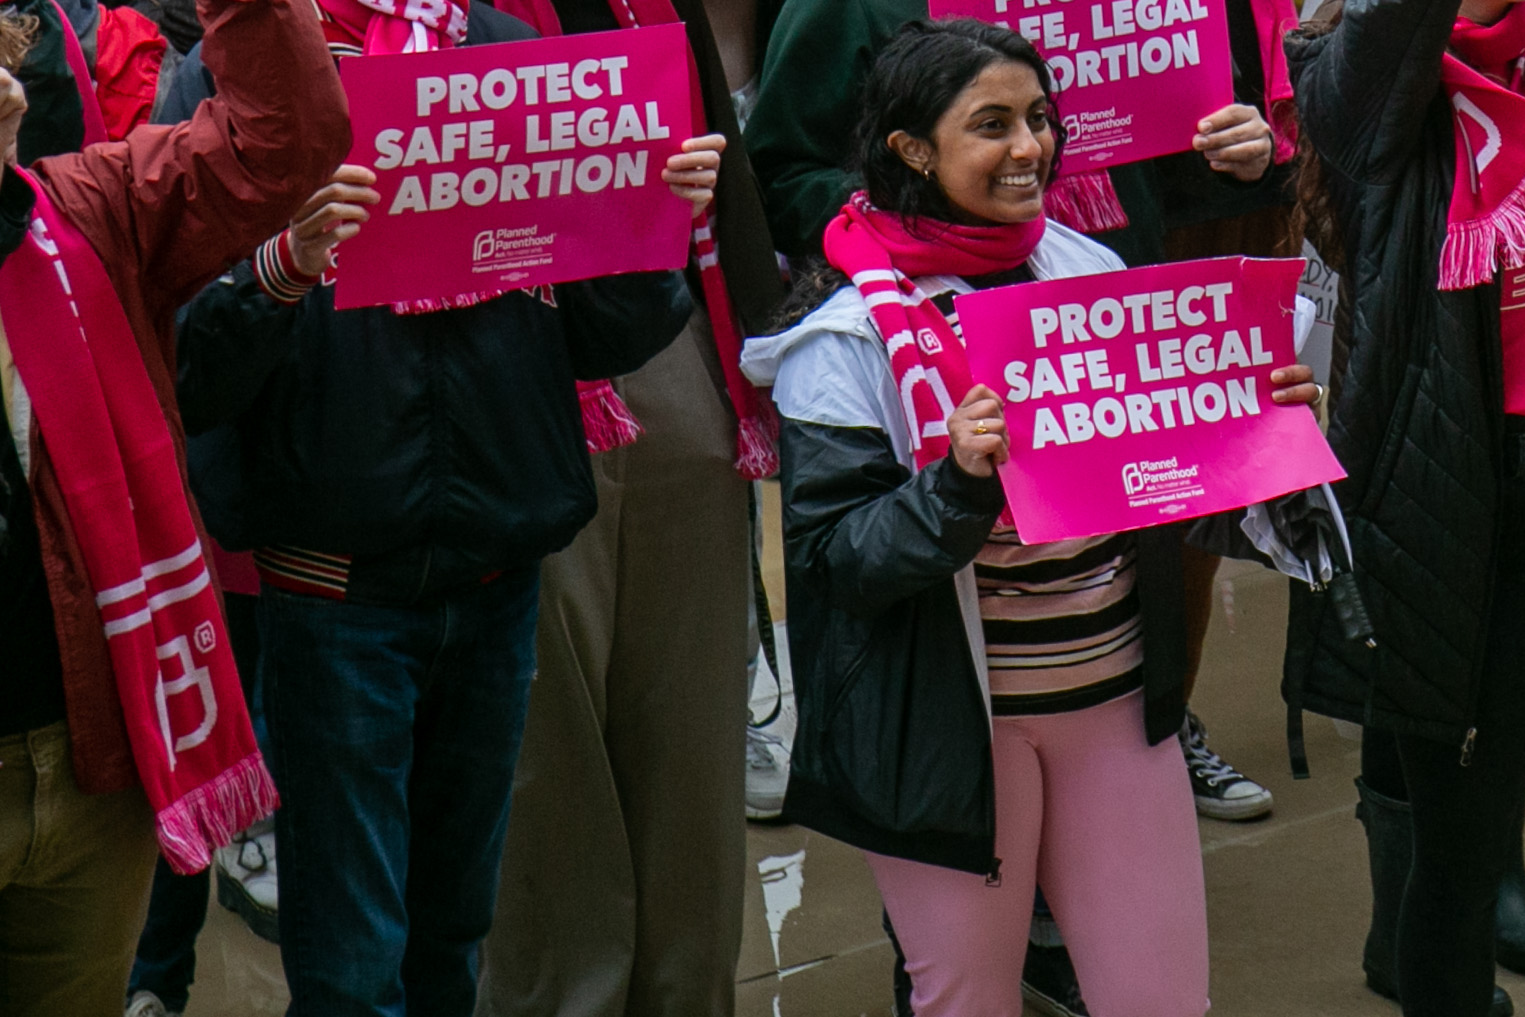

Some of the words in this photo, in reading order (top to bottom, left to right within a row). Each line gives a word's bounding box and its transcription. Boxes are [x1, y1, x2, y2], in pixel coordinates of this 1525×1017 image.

[415, 54, 629, 118] PROTECT
[1047, 29, 1201, 94] ORTION
[373, 118, 511, 170] SAFE,
[525, 100, 670, 154] LEGAL
[387, 149, 649, 216] ABORTION
[1029, 281, 1233, 349] PROTECT
[1002, 348, 1127, 404] SAFE,
[1135, 326, 1274, 384] LEGAL
[1032, 375, 1262, 451] ABORTION
[1139, 456, 1179, 473] Planned
[1142, 465, 1197, 485] Parenthood
